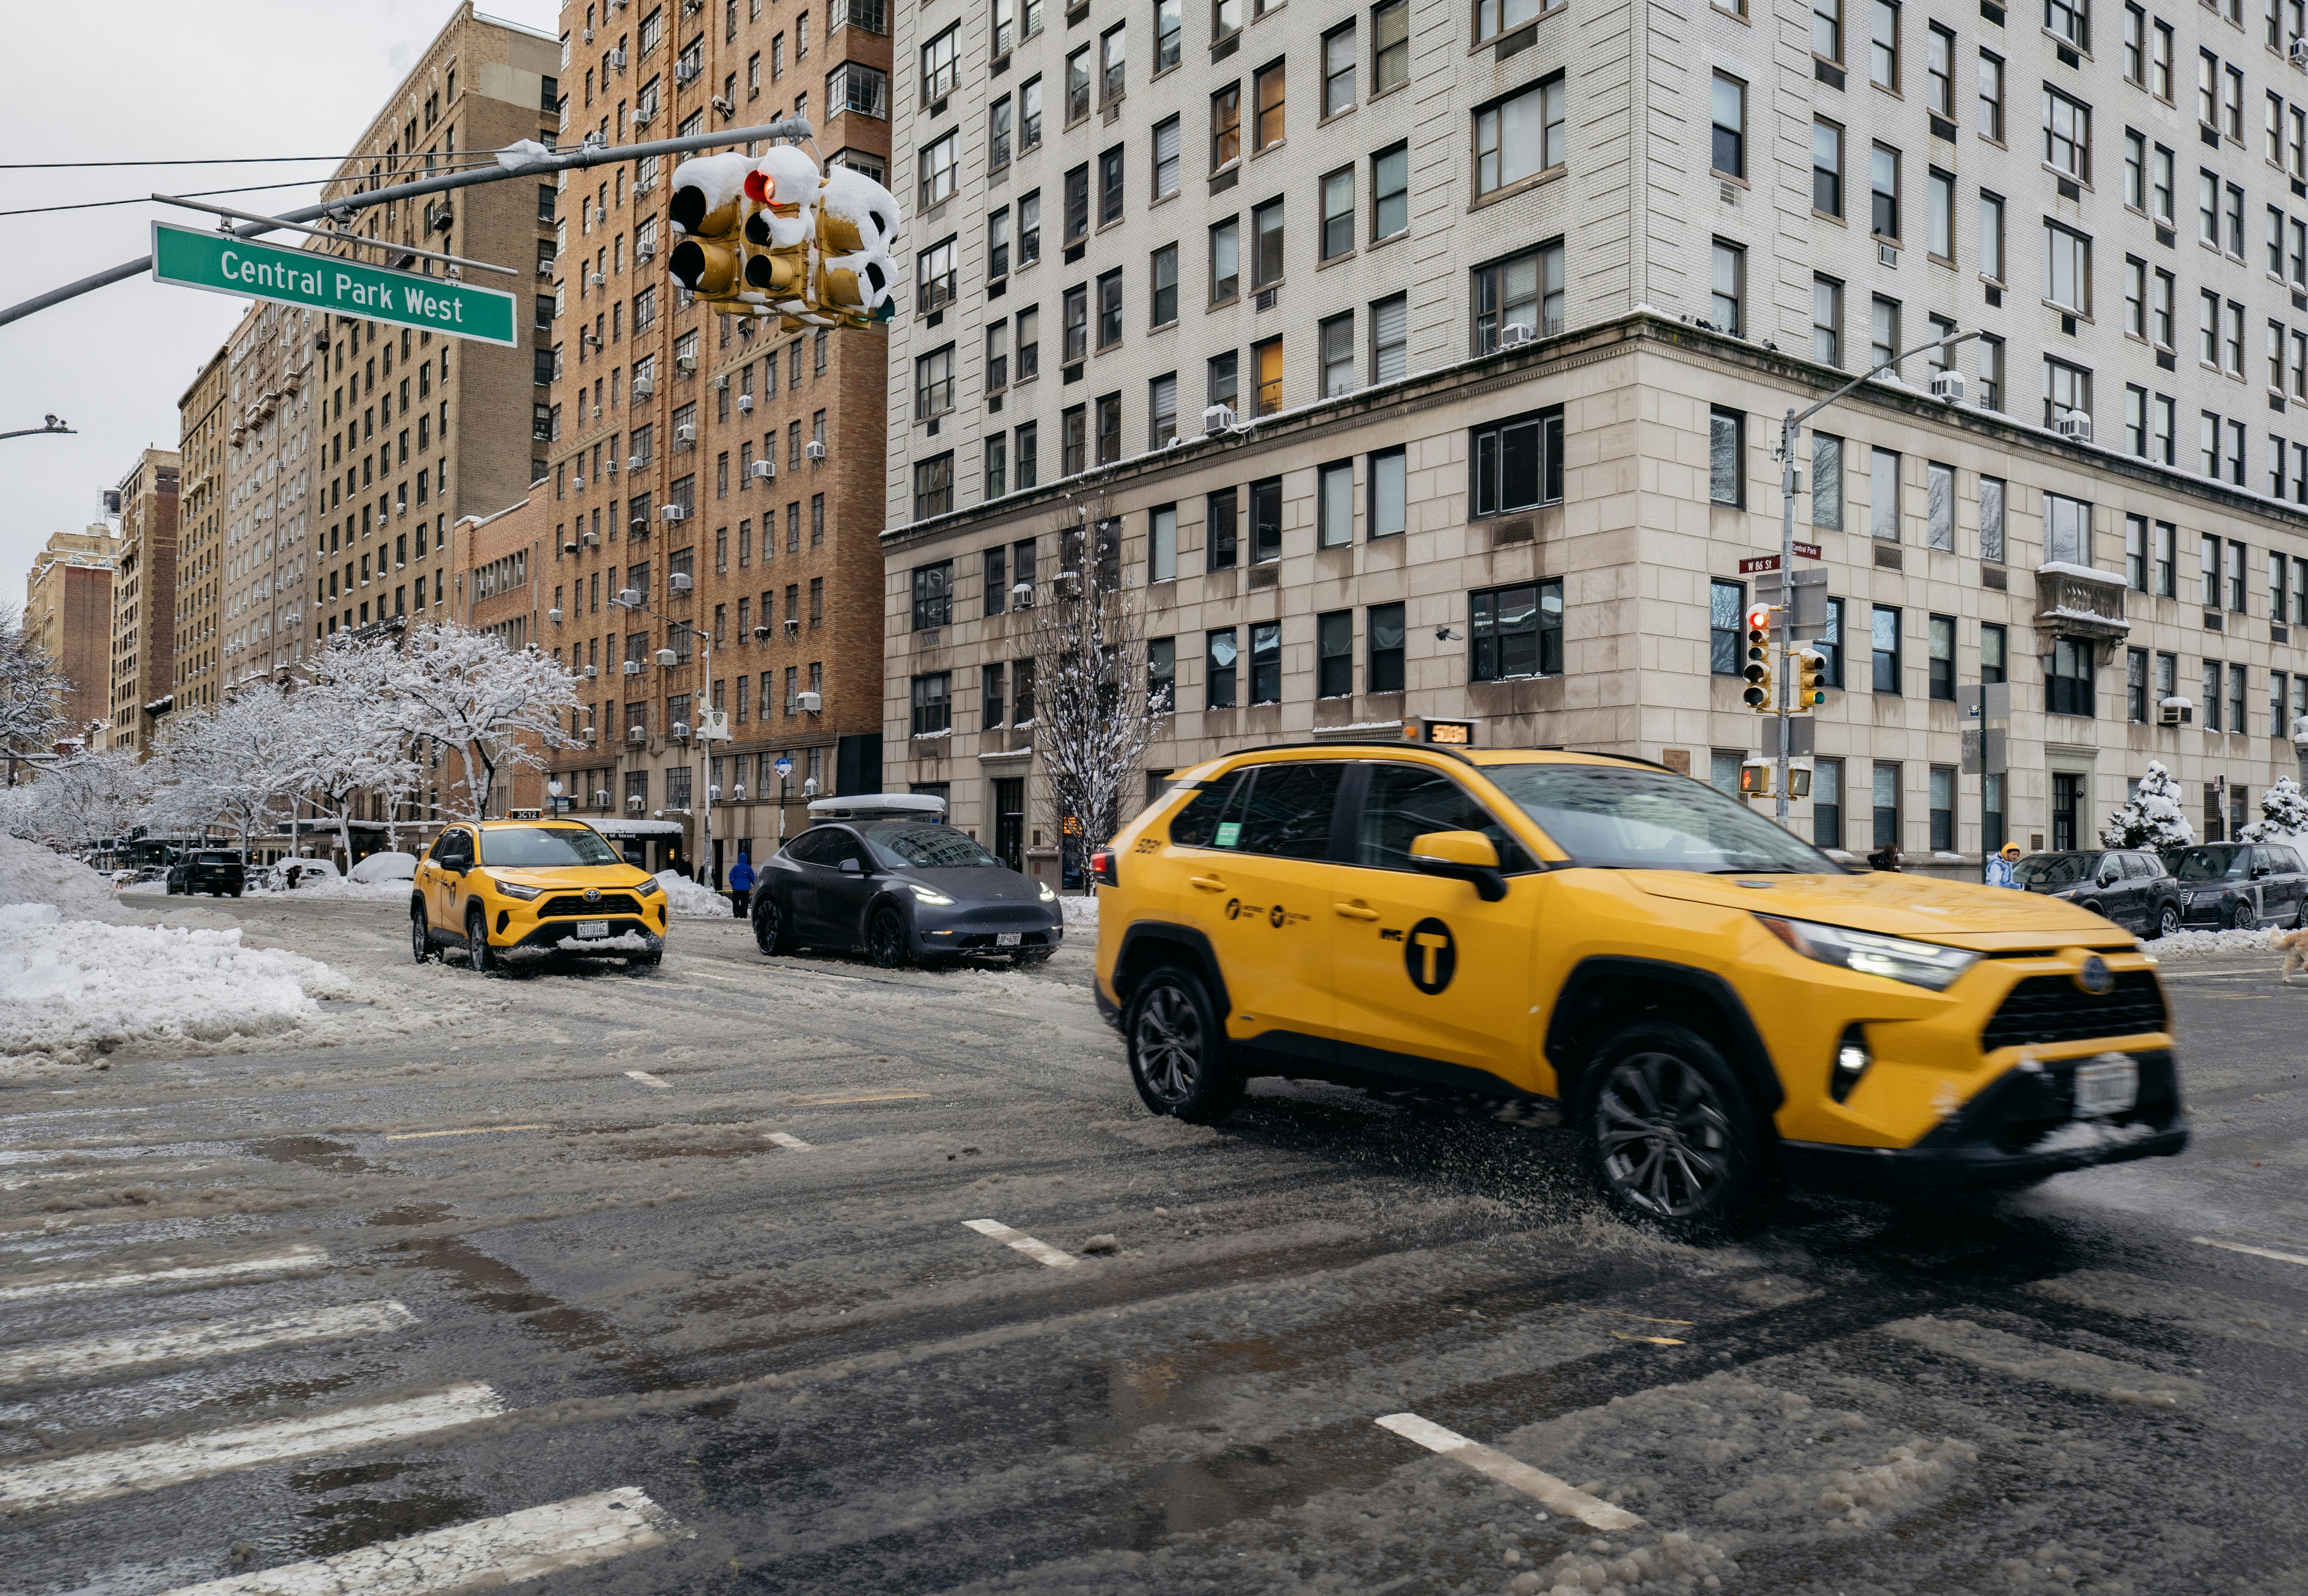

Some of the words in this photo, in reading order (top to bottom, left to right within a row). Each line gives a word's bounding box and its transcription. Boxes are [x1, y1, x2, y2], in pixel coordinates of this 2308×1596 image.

[221, 251, 322, 296] Central
[336, 273, 393, 310] Park
[404, 286, 463, 322] West
[1792, 543, 1806, 553] Central
[1748, 562, 1753, 571] W
[1755, 561, 1763, 570] 86
[1765, 560, 1772, 569] St
[580, 925, 605, 934] Y211016C
[1415, 932, 1448, 985] T
